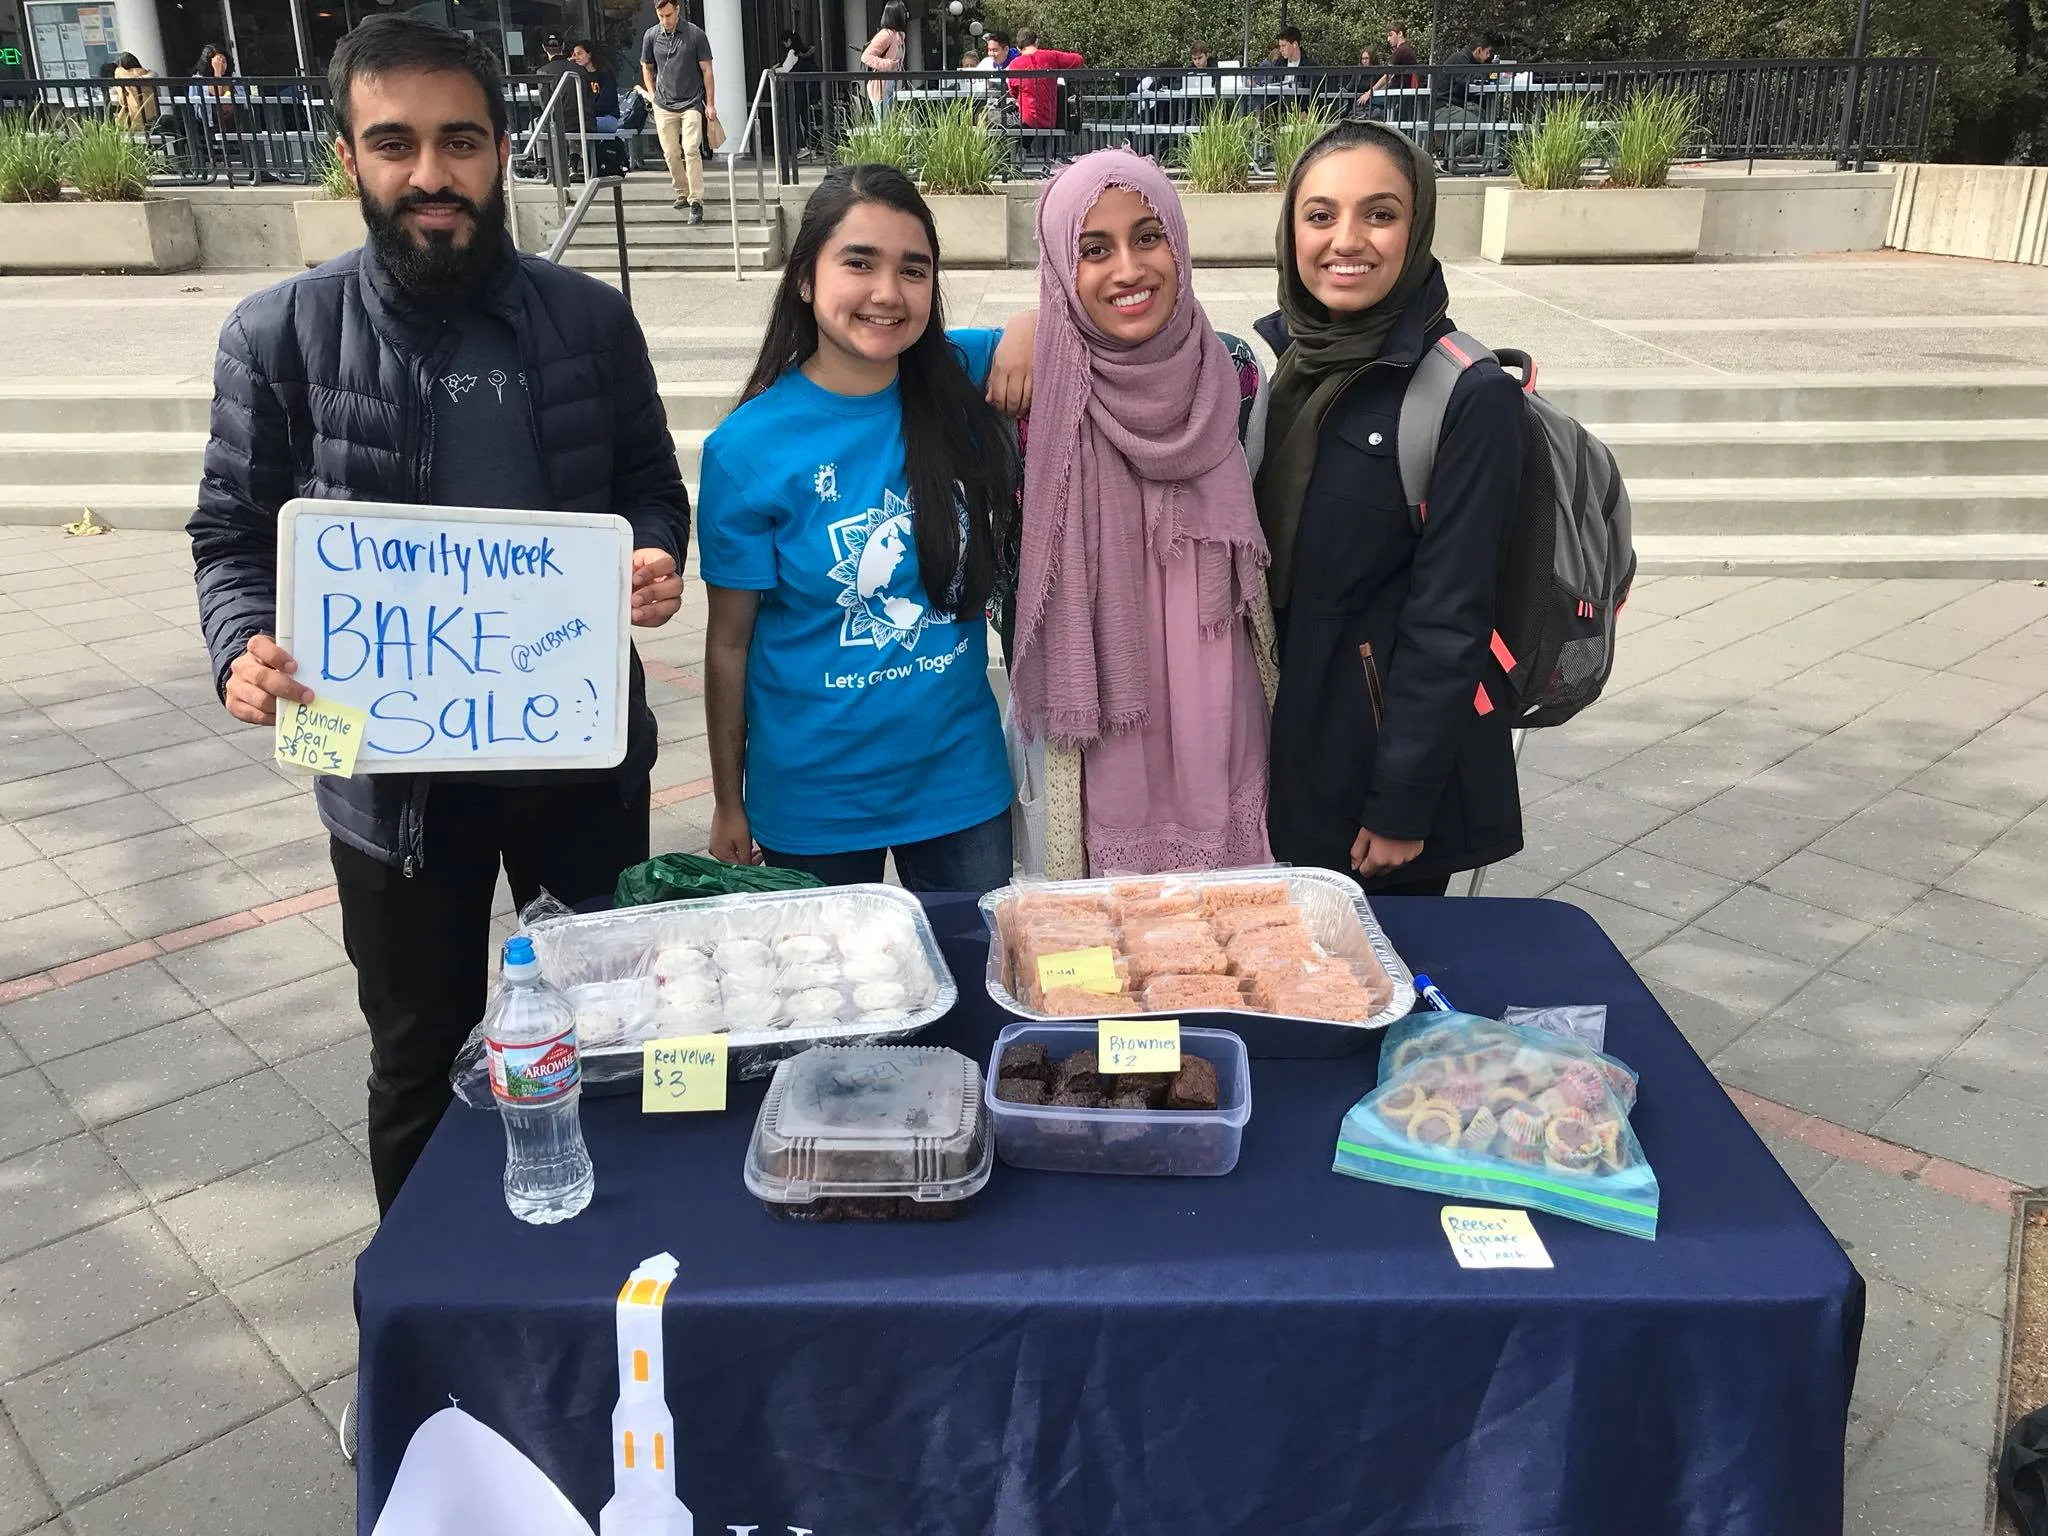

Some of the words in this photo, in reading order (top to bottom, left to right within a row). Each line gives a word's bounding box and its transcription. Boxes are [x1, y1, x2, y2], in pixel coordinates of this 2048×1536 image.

[317, 521, 470, 595] Charity
[478, 537, 563, 580] Week
[321, 593, 511, 681] BAKE
[825, 671, 865, 688] Let's
[868, 664, 913, 685] Grow
[296, 704, 351, 735] Bundle
[295, 725, 327, 750] Deal
[1110, 1035, 1176, 1052] Brownies
[654, 1049, 676, 1065] Red
[681, 1049, 716, 1067] Velvet
